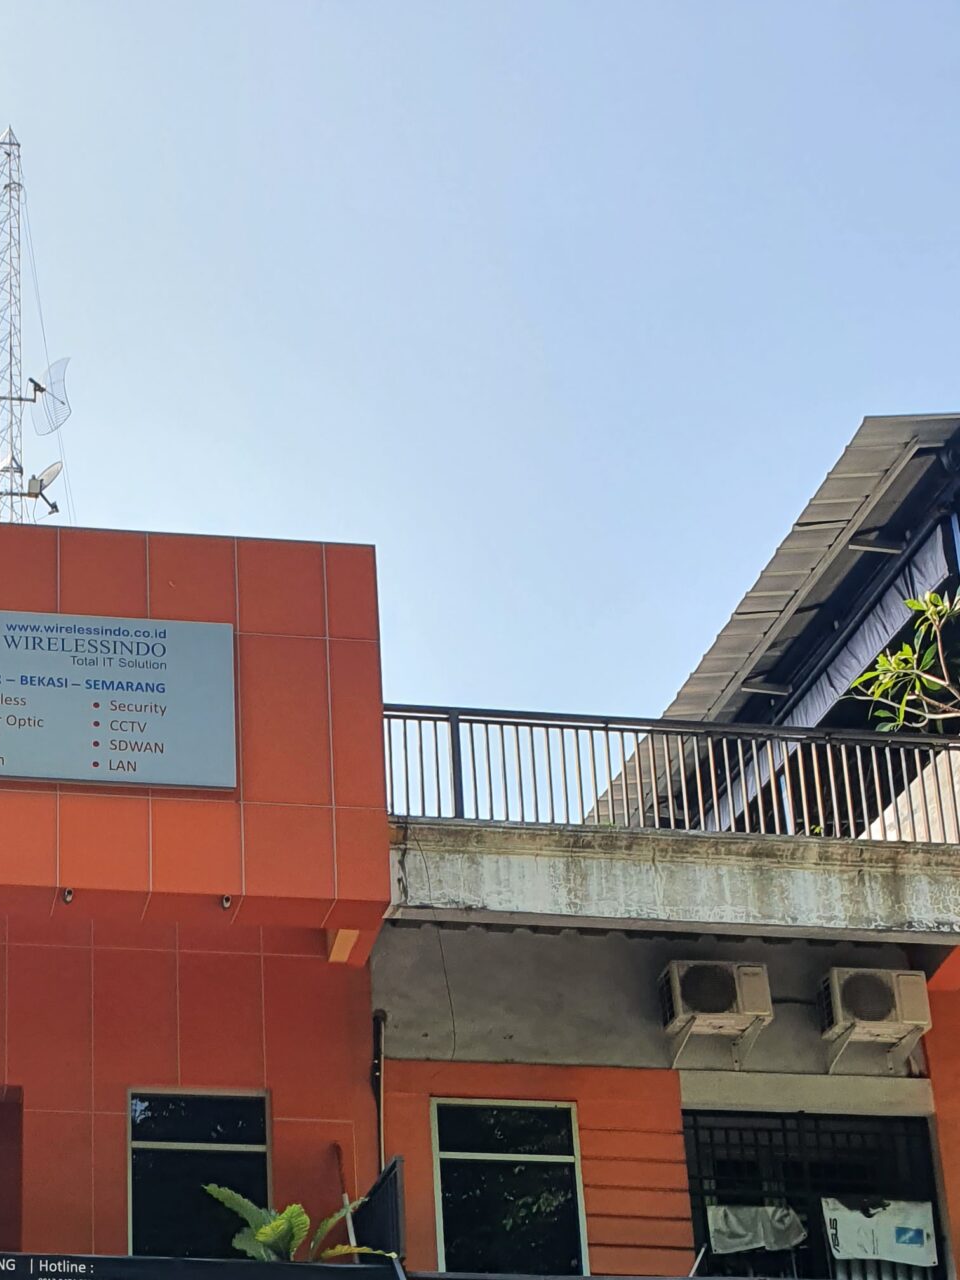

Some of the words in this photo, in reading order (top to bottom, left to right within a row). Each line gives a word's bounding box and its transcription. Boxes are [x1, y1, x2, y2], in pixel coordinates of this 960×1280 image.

[6, 623, 167, 639] www.wirelessindo.co.id
[4, 635, 167, 657] WIRELESSINDO
[70, 655, 100, 667] Total
[103, 657, 113, 668] IT
[118, 657, 167, 670] Solution
[20, 675, 68, 689] BEKASI
[85, 679, 166, 694] SEMARANG
[109, 700, 167, 716] Security
[6, 714, 44, 728] Optic
[109, 719, 147, 733] CCTV
[109, 739, 165, 754] SDWAN
[109, 759, 137, 772] LAN
[39, 1260, 86, 1273] Hotline
